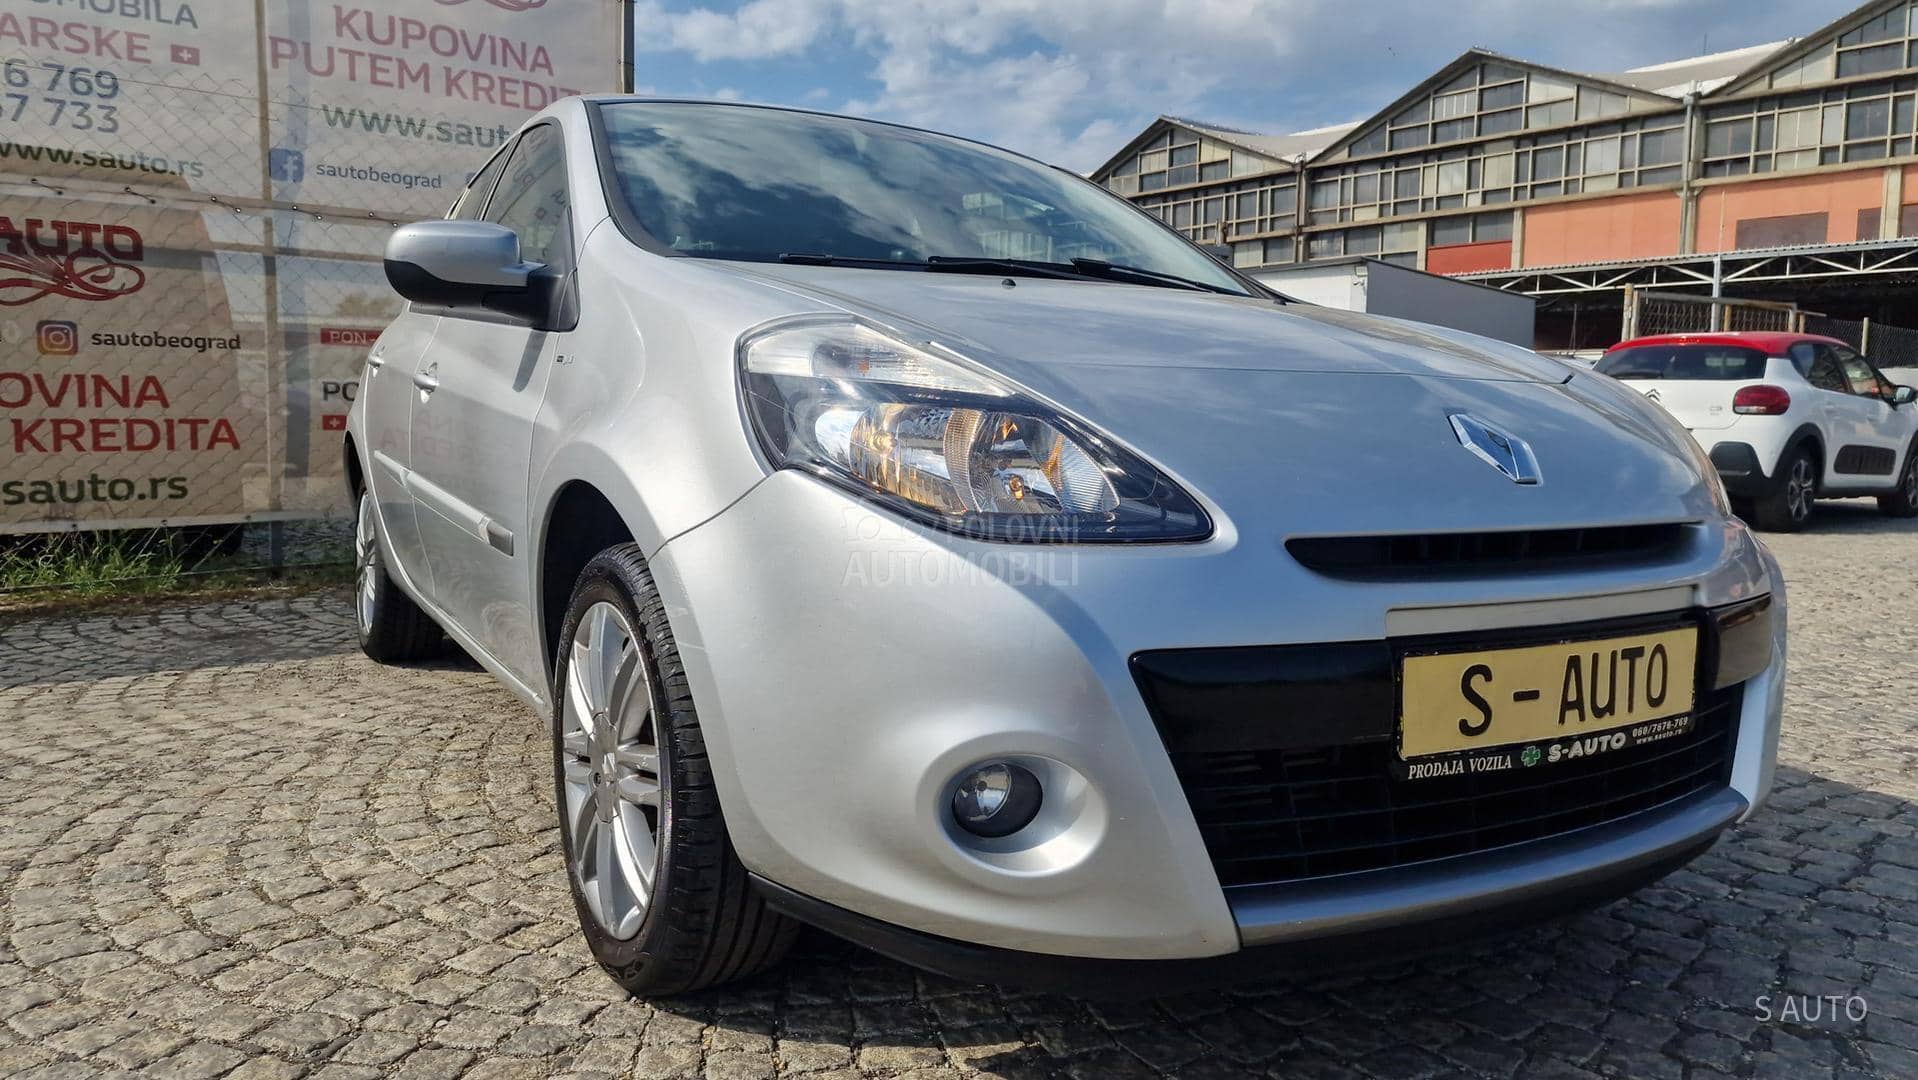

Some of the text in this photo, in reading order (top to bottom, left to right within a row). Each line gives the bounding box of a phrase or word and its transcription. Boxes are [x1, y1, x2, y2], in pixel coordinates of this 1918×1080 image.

[333, 4, 554, 77] KUPOVINA
[42, 62, 119, 99] 769
[269, 36, 431, 94] PUTEM
[43, 97, 119, 134] 733
[316, 162, 442, 190] sautobeograd
[91, 331, 242, 354] sautobeograd
[0, 372, 170, 409] OVINA
[11, 418, 241, 452] KREDITA
[2, 473, 188, 505] sauto.rs
[1458, 664, 1493, 737] S
[1558, 643, 1668, 726] AUTO
[1547, 731, 1626, 763] S-AUTO
[1408, 754, 1512, 780] PRODAJA VOZILA
